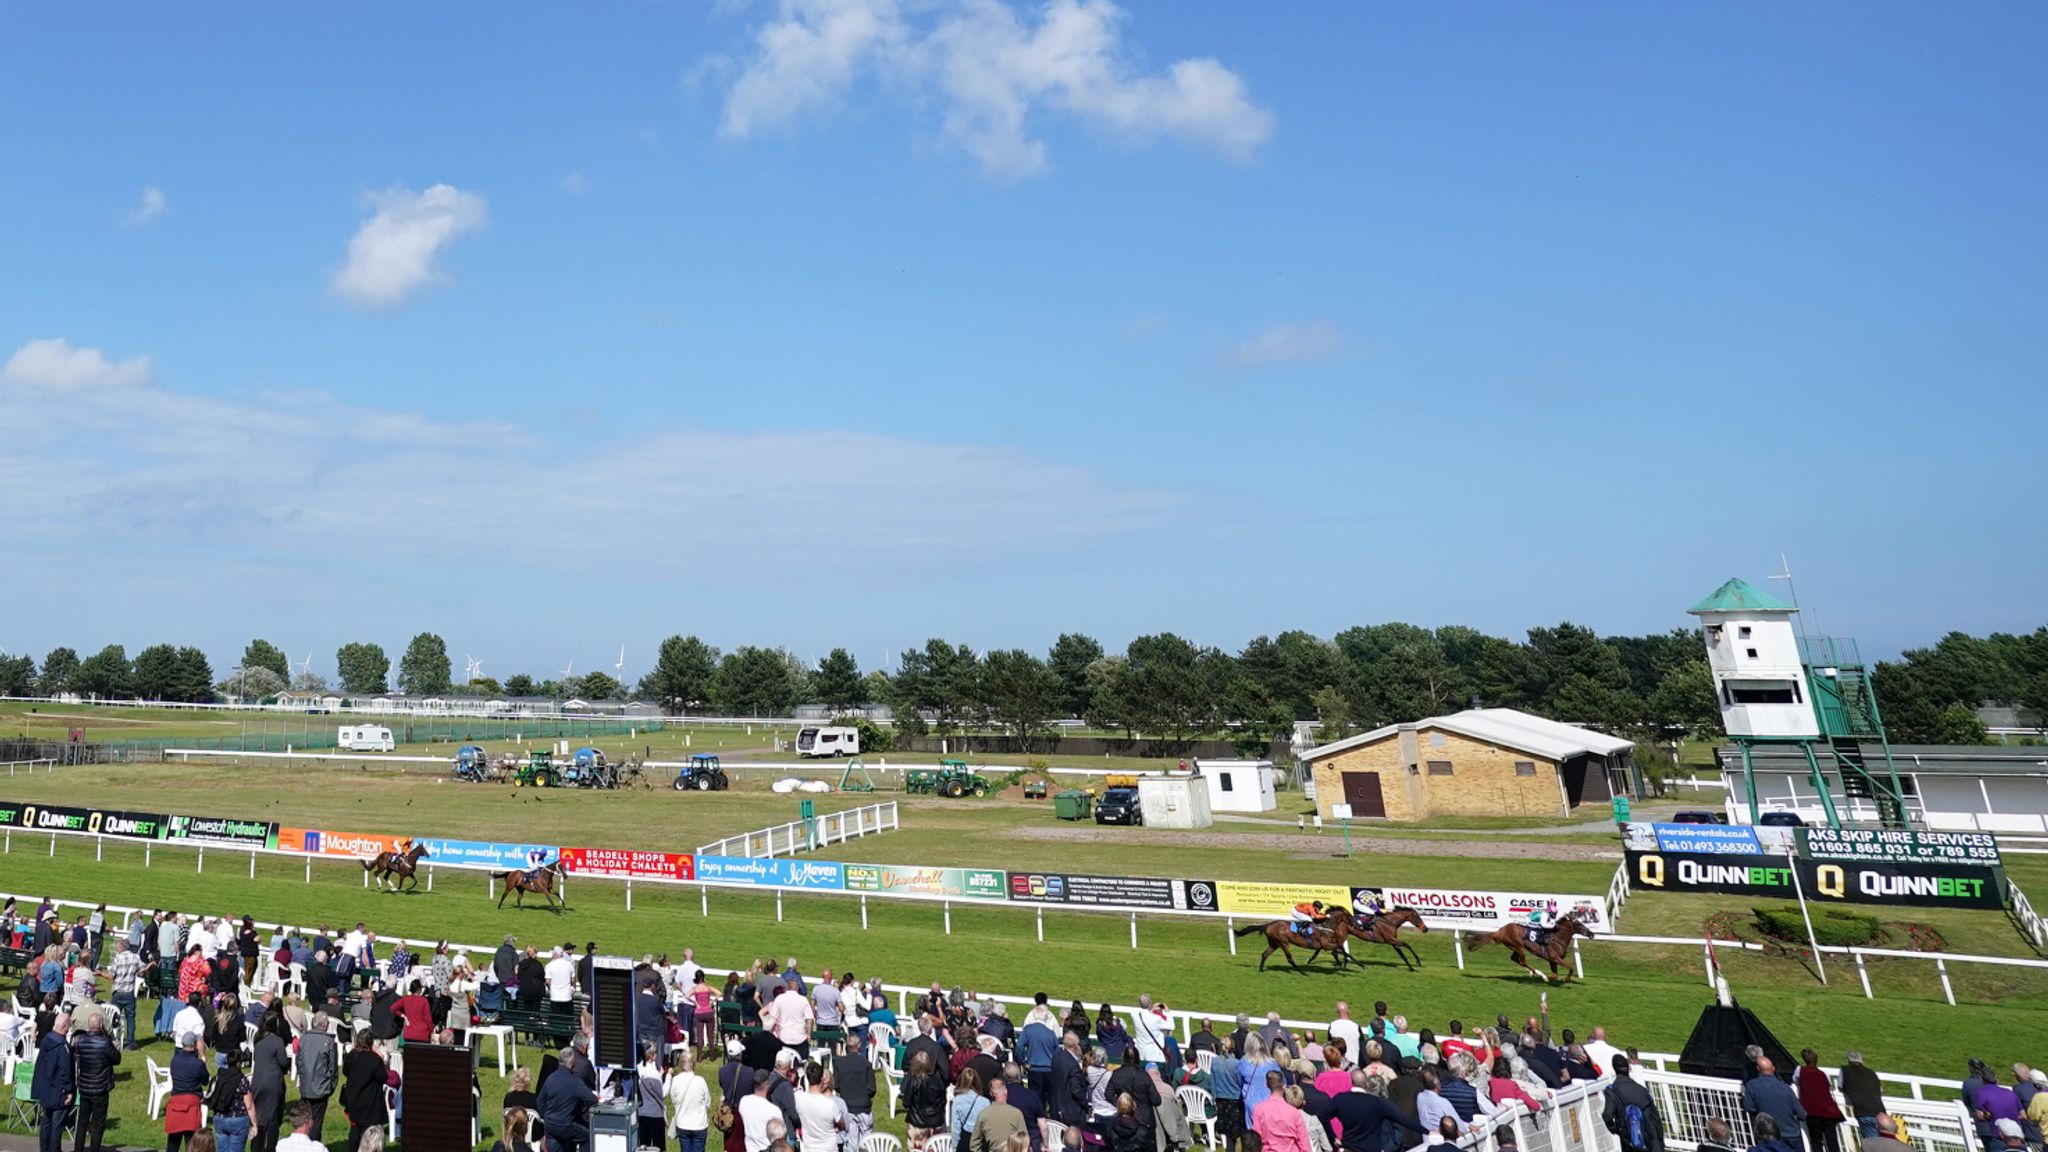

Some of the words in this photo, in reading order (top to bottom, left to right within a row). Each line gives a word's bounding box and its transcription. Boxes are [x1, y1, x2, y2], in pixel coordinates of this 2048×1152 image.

[38, 810, 85, 829] QUINNBET
[105, 816, 157, 835] QUINNBET
[190, 818, 227, 834] Lowestoft
[226, 820, 267, 838] Hydraulics
[1658, 827, 1750, 839] riverside-rentals.co.uk
[1807, 829, 1838, 841] AKS
[1841, 830, 1875, 843] SKIP
[1878, 831, 1914, 844] HIRE
[1917, 832, 1994, 847] SERVICES
[326, 835, 382, 854] Moughton
[443, 841, 464, 855] home
[465, 844, 501, 862] ownership
[504, 847, 524, 860] with
[1680, 841, 1714, 852] 01493
[1716, 842, 1757, 853] 368300
[1808, 841, 1852, 852] 01603
[1856, 843, 1882, 854] 865
[1885, 844, 1912, 855] 031
[1918, 847, 1935, 856] or
[1936, 846, 1966, 858] 789
[1969, 847, 1997, 859] 555
[585, 849, 630, 861] SEADELL
[632, 852, 665, 863] SHOPS
[576, 858, 583, 867] &
[586, 859, 628, 870] HOLIDAY
[631, 861, 676, 873] CHALETS
[700, 859, 721, 876] Enjoy
[725, 860, 767, 878] ownership
[769, 862, 778, 875] at
[803, 863, 837, 877] Haven
[848, 869, 878, 877] NO.1
[1639, 855, 1665, 887] Q
[1678, 860, 1793, 887] QUINNBET
[1816, 864, 1845, 899] Q
[1859, 870, 1985, 898] QUINNBET
[1390, 892, 1497, 909] NICHOLSONS
[1510, 899, 1545, 908] CASE
[1436, 908, 1471, 918] Engineering
